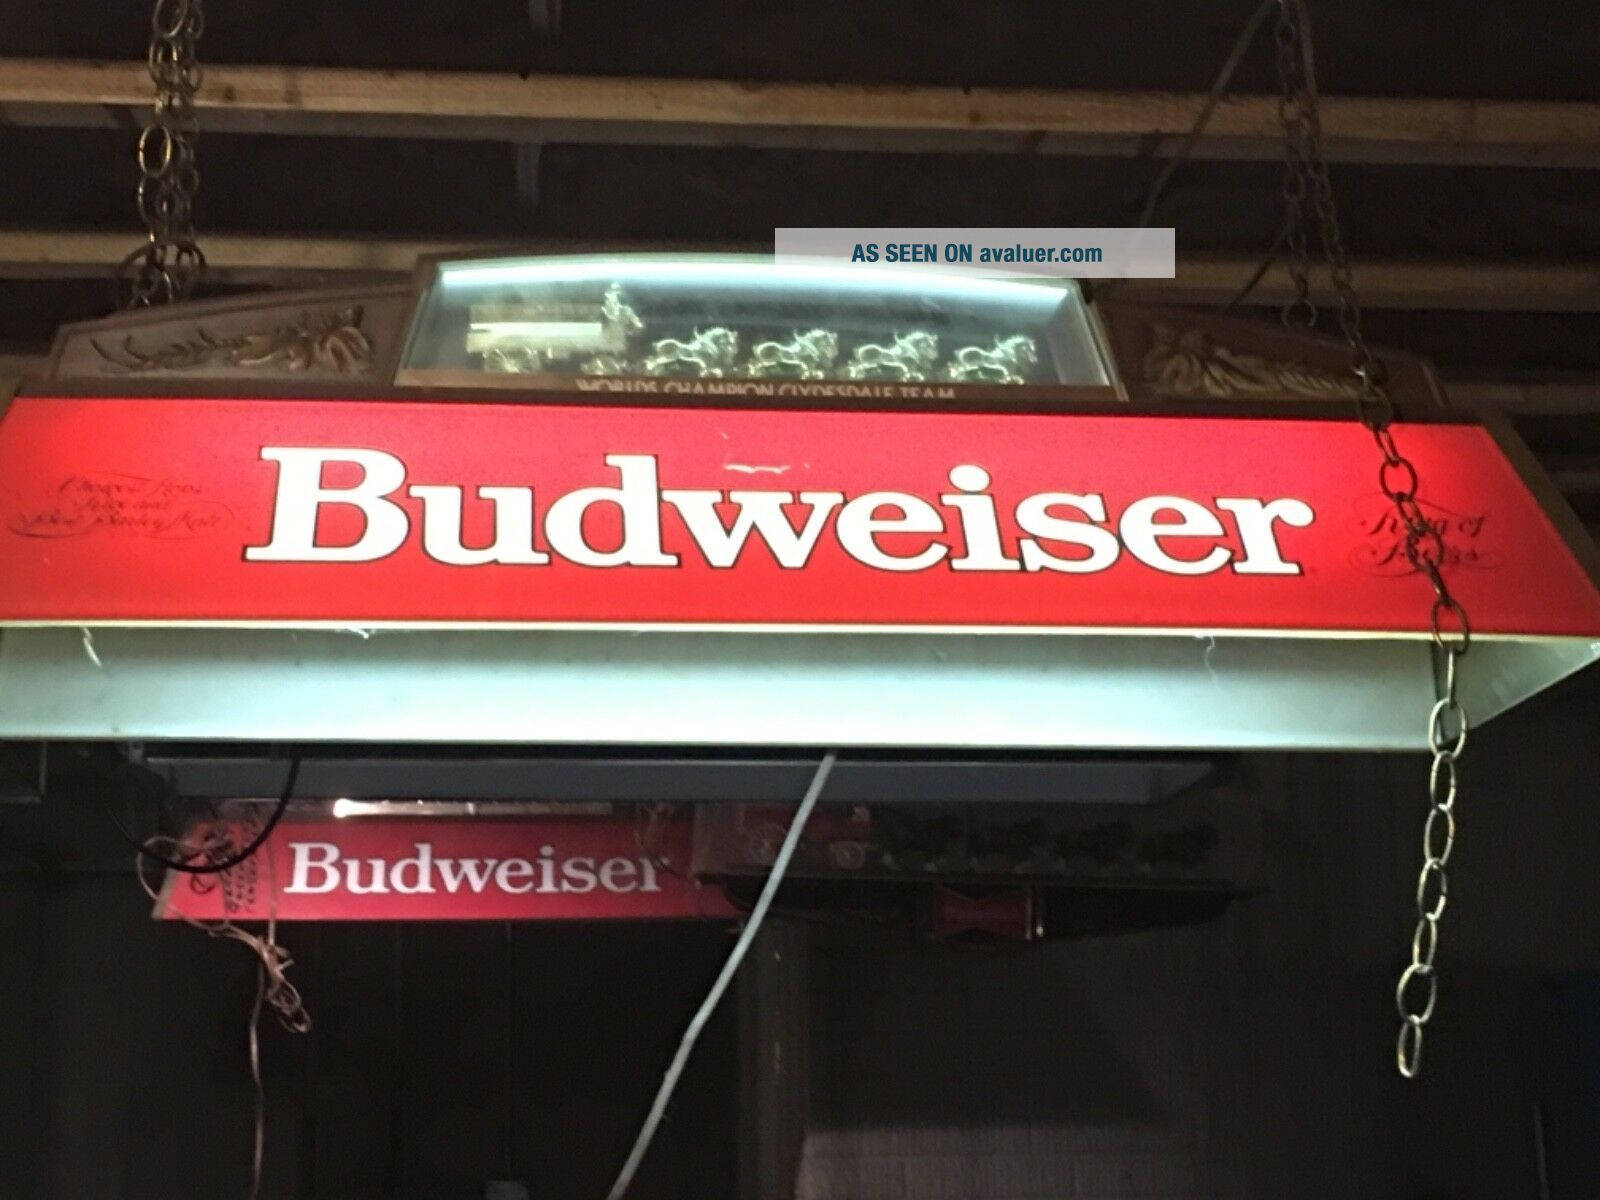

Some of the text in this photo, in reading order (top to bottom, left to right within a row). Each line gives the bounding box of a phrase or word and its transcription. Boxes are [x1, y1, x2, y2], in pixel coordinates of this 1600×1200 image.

[663, 381, 774, 396] CHAMPION
[778, 383, 895, 398] CLYDESDALE
[900, 386, 957, 399] TEAM
[242, 445, 1315, 577] Budweiser
[283, 842, 672, 895] Budweiser
